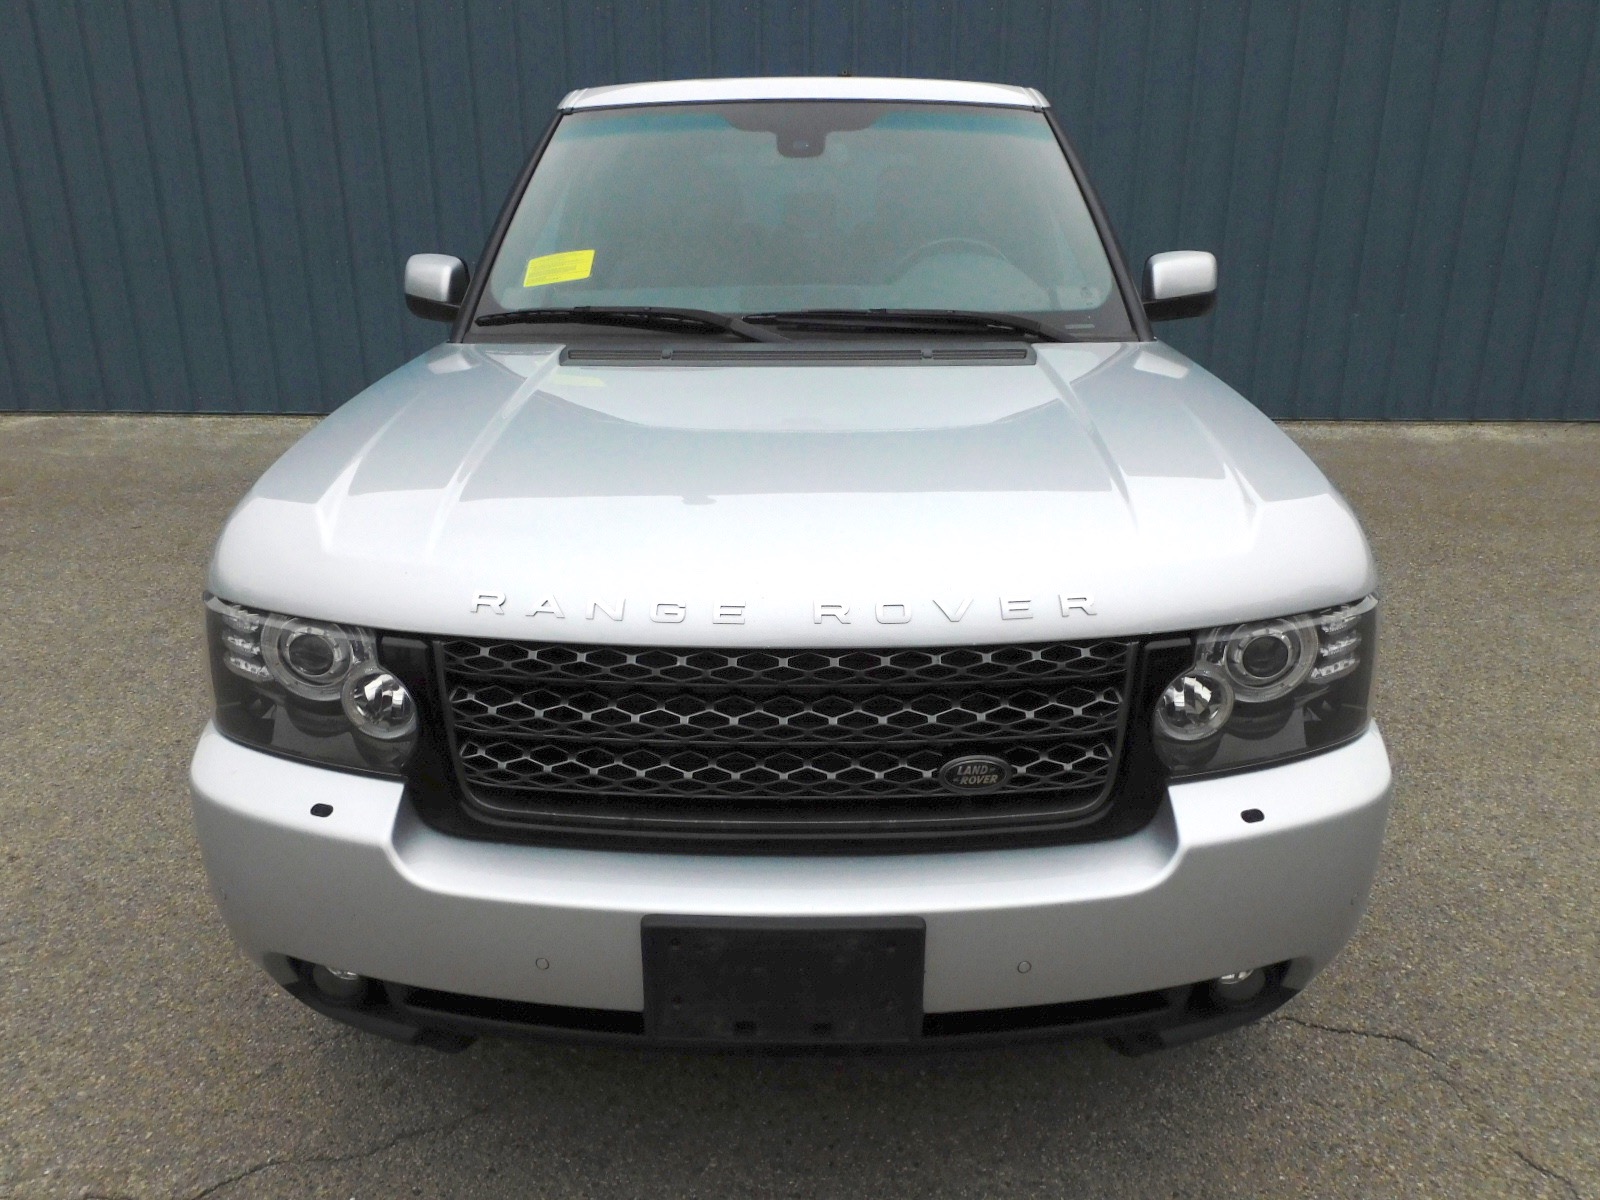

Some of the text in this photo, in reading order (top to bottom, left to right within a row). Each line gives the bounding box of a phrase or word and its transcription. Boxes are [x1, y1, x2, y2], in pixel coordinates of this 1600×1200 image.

[470, 590, 1098, 625] RANGE ROVER
[956, 765, 989, 776] LAND
[960, 774, 999, 785] ROVER
